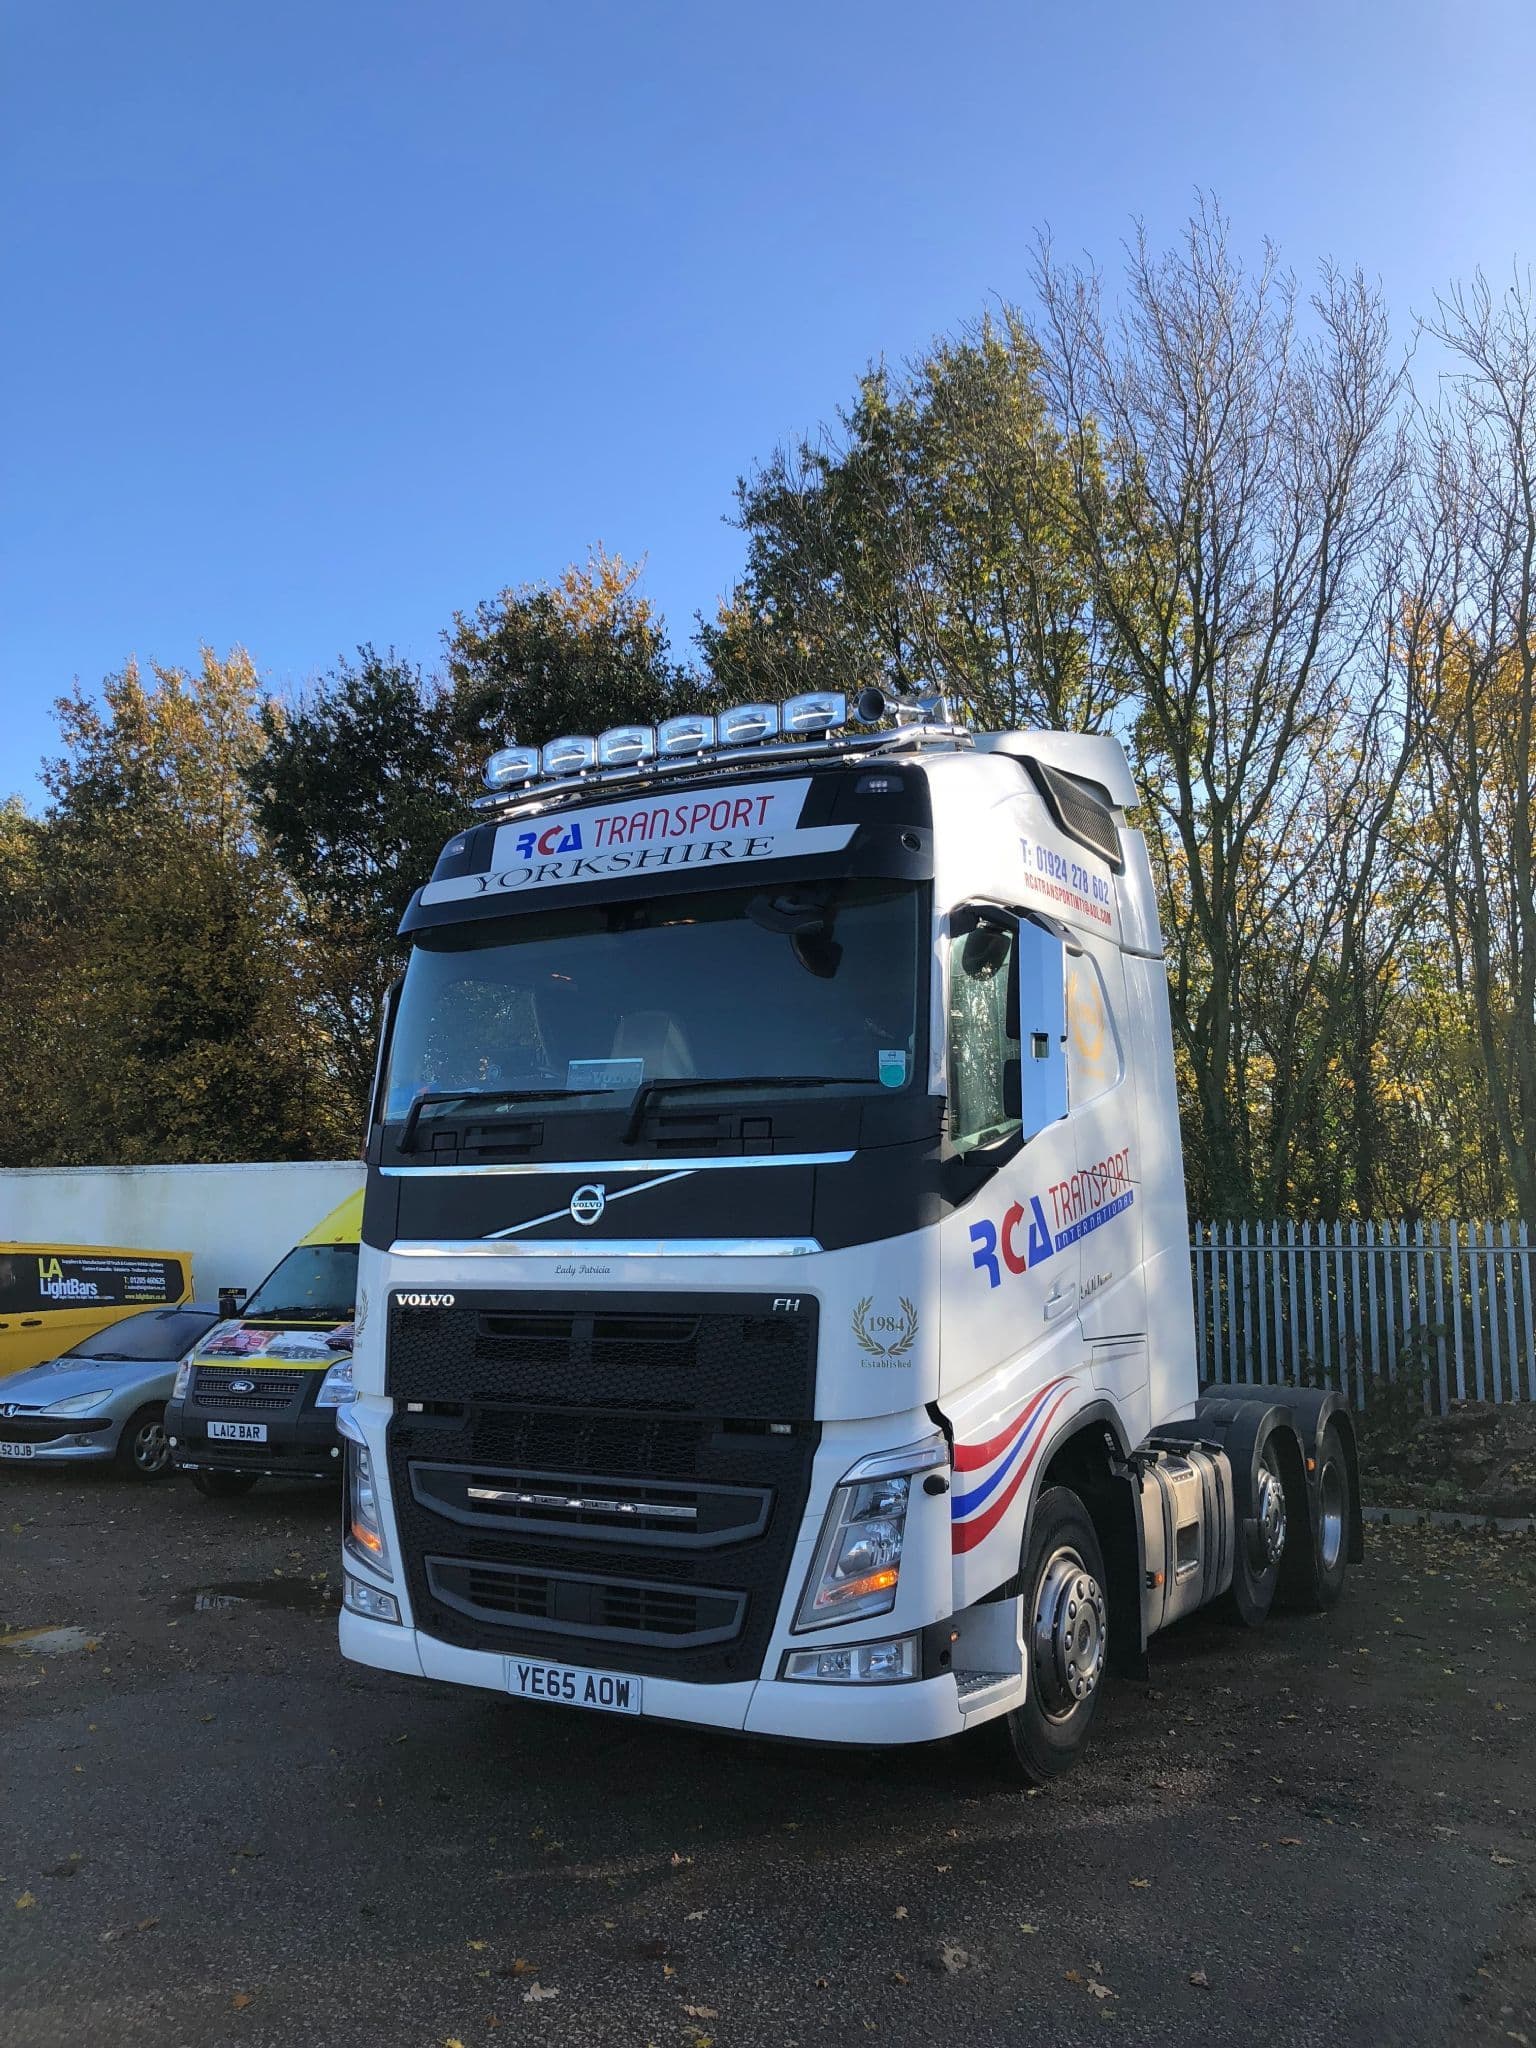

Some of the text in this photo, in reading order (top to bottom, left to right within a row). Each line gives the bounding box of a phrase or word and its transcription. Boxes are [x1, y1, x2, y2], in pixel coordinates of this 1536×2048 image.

[516, 796, 775, 859] RCA TRANSPORT
[474, 836, 775, 893] YORKSHIRE
[1036, 845, 1068, 883] 01924
[1071, 863, 1089, 894] 278
[1092, 875, 1110, 905] 602
[969, 1147, 1131, 1288] RCA TRANSPORT
[1056, 1194, 1133, 1250] INTERNATIONAL
[38, 1257, 64, 1278] LA
[555, 1265, 577, 1276] Lady
[40, 1278, 98, 1299] LightBars
[395, 1293, 455, 1306] VOLVO
[772, 1298, 800, 1312] FH
[869, 1316, 905, 1332] 1984
[860, 1359, 912, 1369] Established
[213, 1423, 260, 1439] LA12 BAR
[14, 1445, 32, 1456] OJB
[517, 1664, 630, 1708] YE65 AOW
